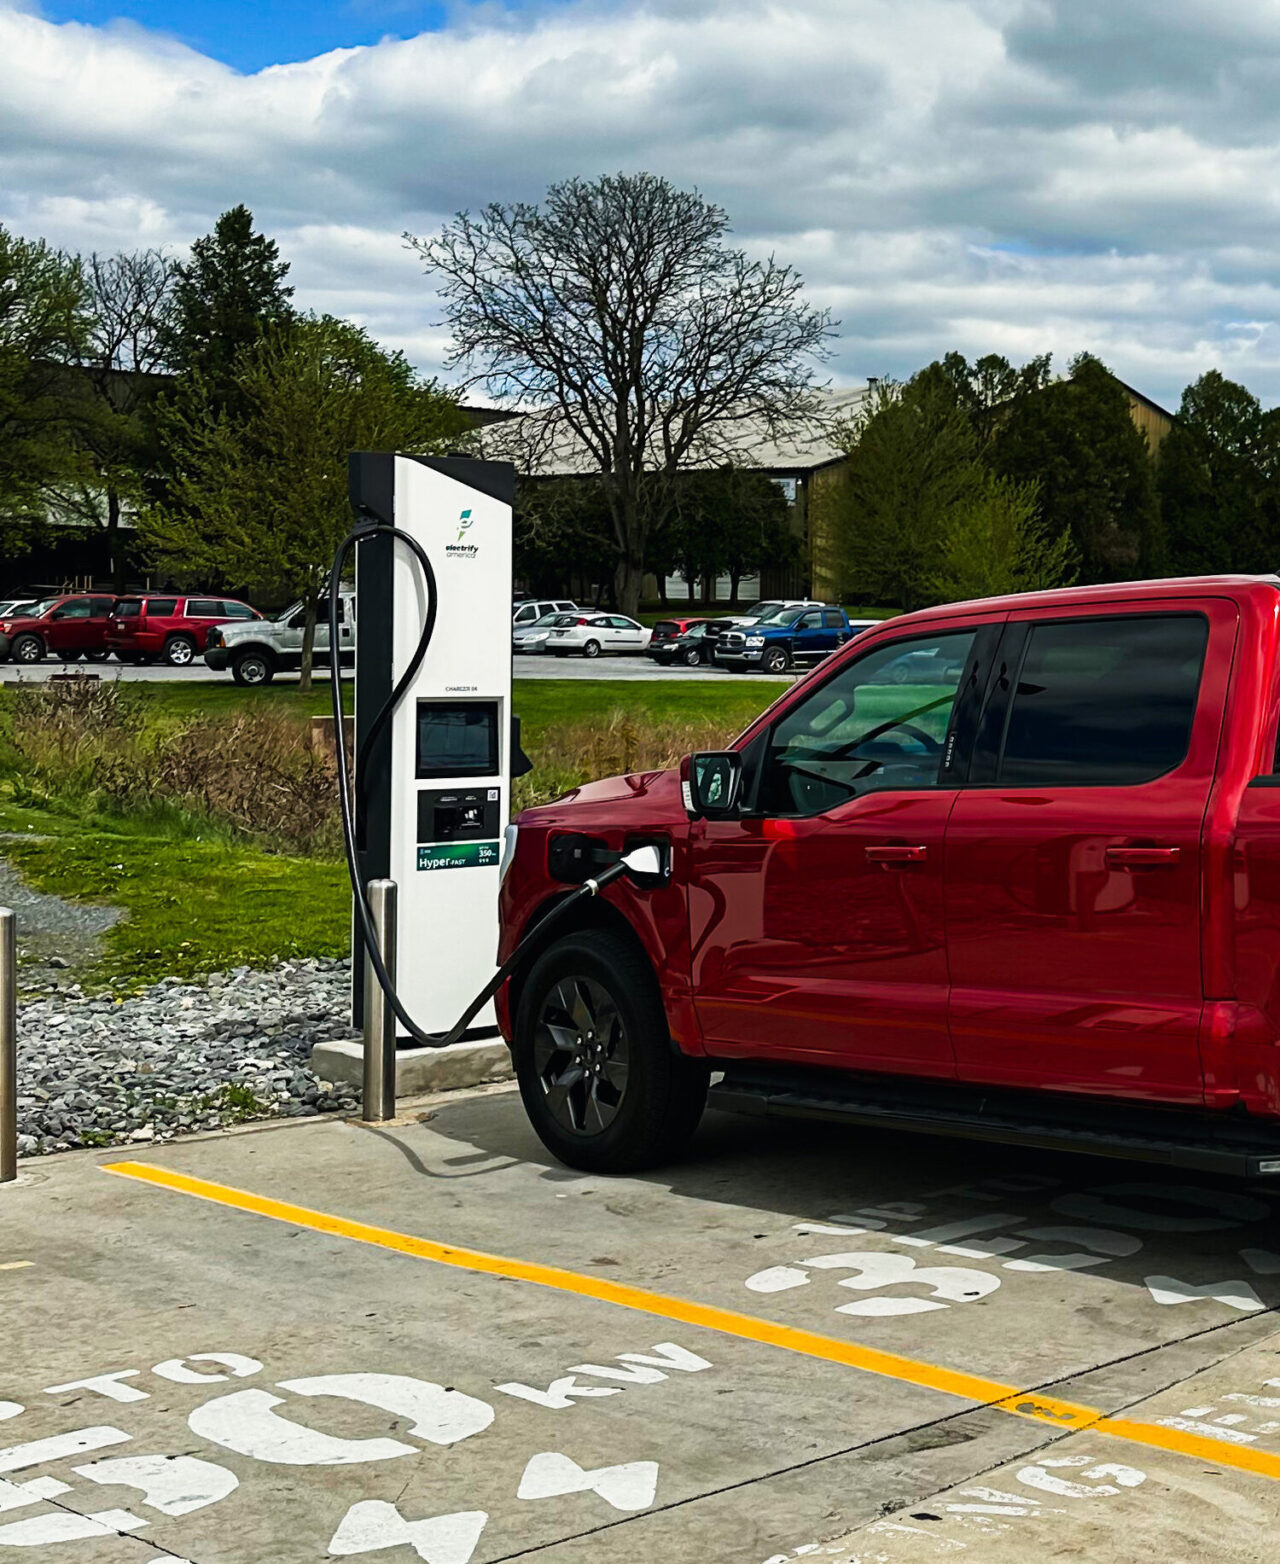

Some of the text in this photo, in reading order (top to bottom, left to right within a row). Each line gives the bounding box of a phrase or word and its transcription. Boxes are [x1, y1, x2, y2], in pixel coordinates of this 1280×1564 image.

[445, 544, 479, 554] electrify
[479, 849, 492, 858] 350
[744, 1182, 1272, 1317] 350
[43, 1352, 264, 1403] TO
